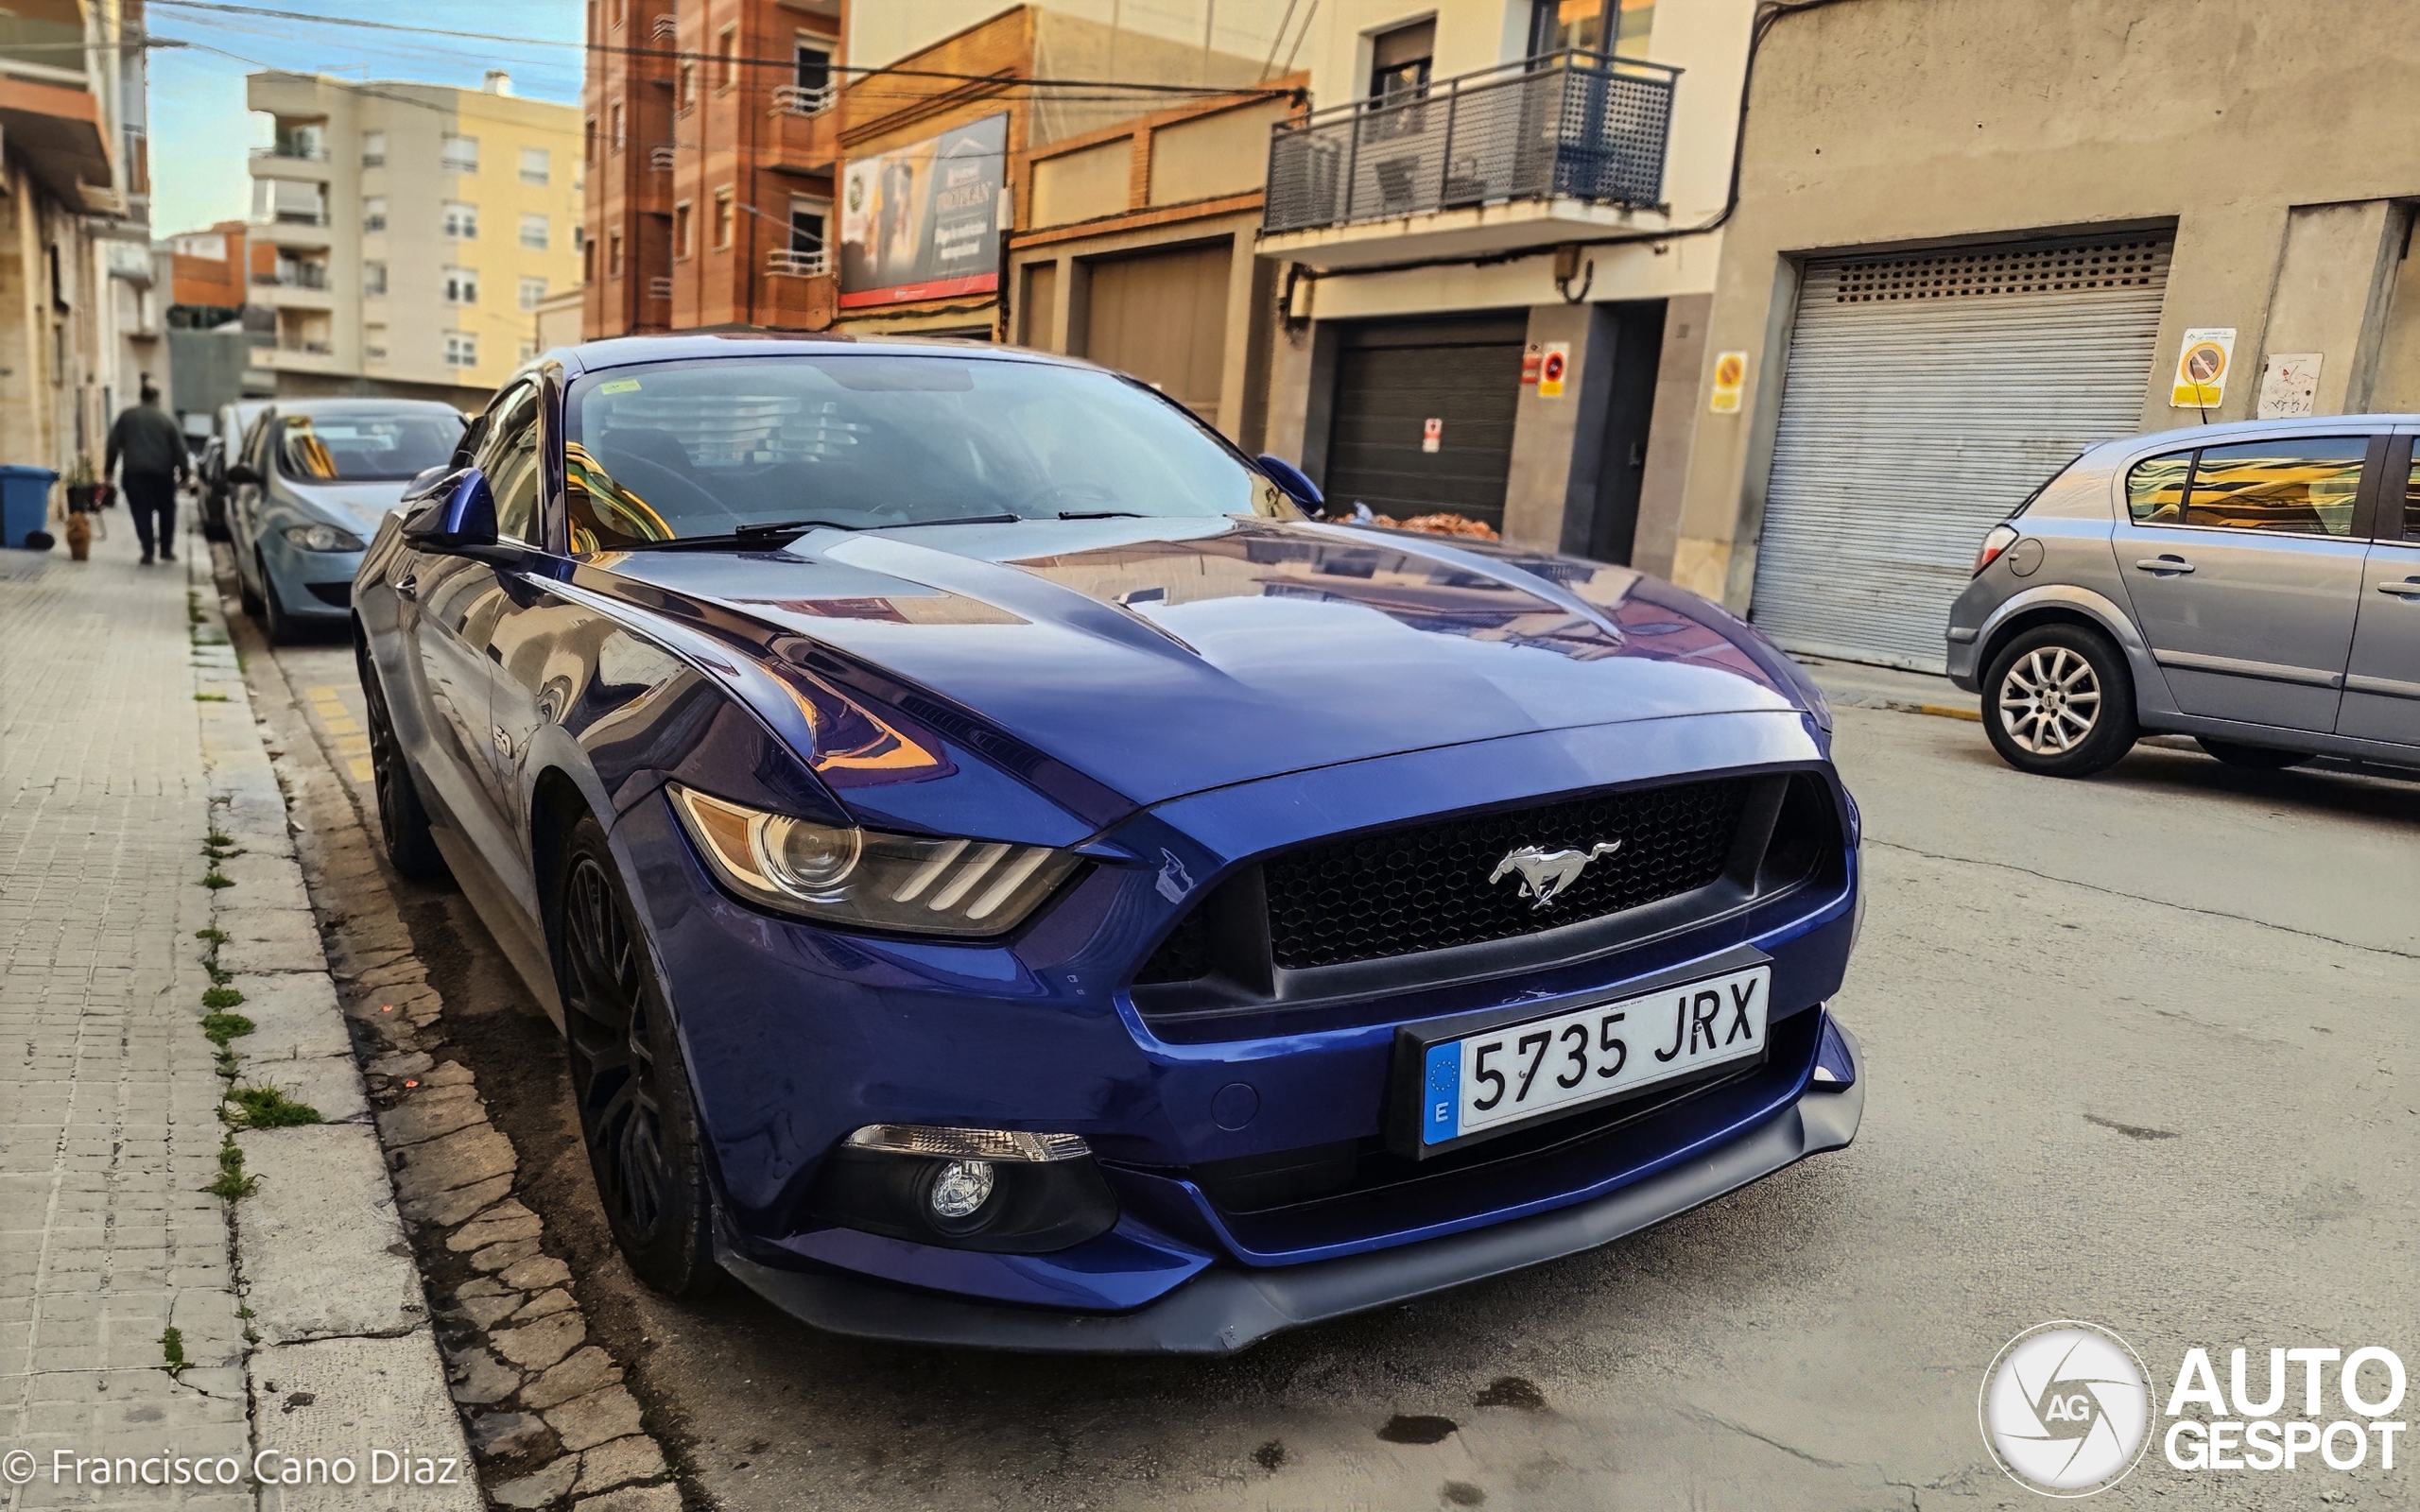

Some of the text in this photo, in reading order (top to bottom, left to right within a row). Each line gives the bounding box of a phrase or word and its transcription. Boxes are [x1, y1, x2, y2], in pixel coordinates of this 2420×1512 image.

[1472, 977, 1758, 1112] 5735 JRX
[1434, 1101, 1449, 1124] E
